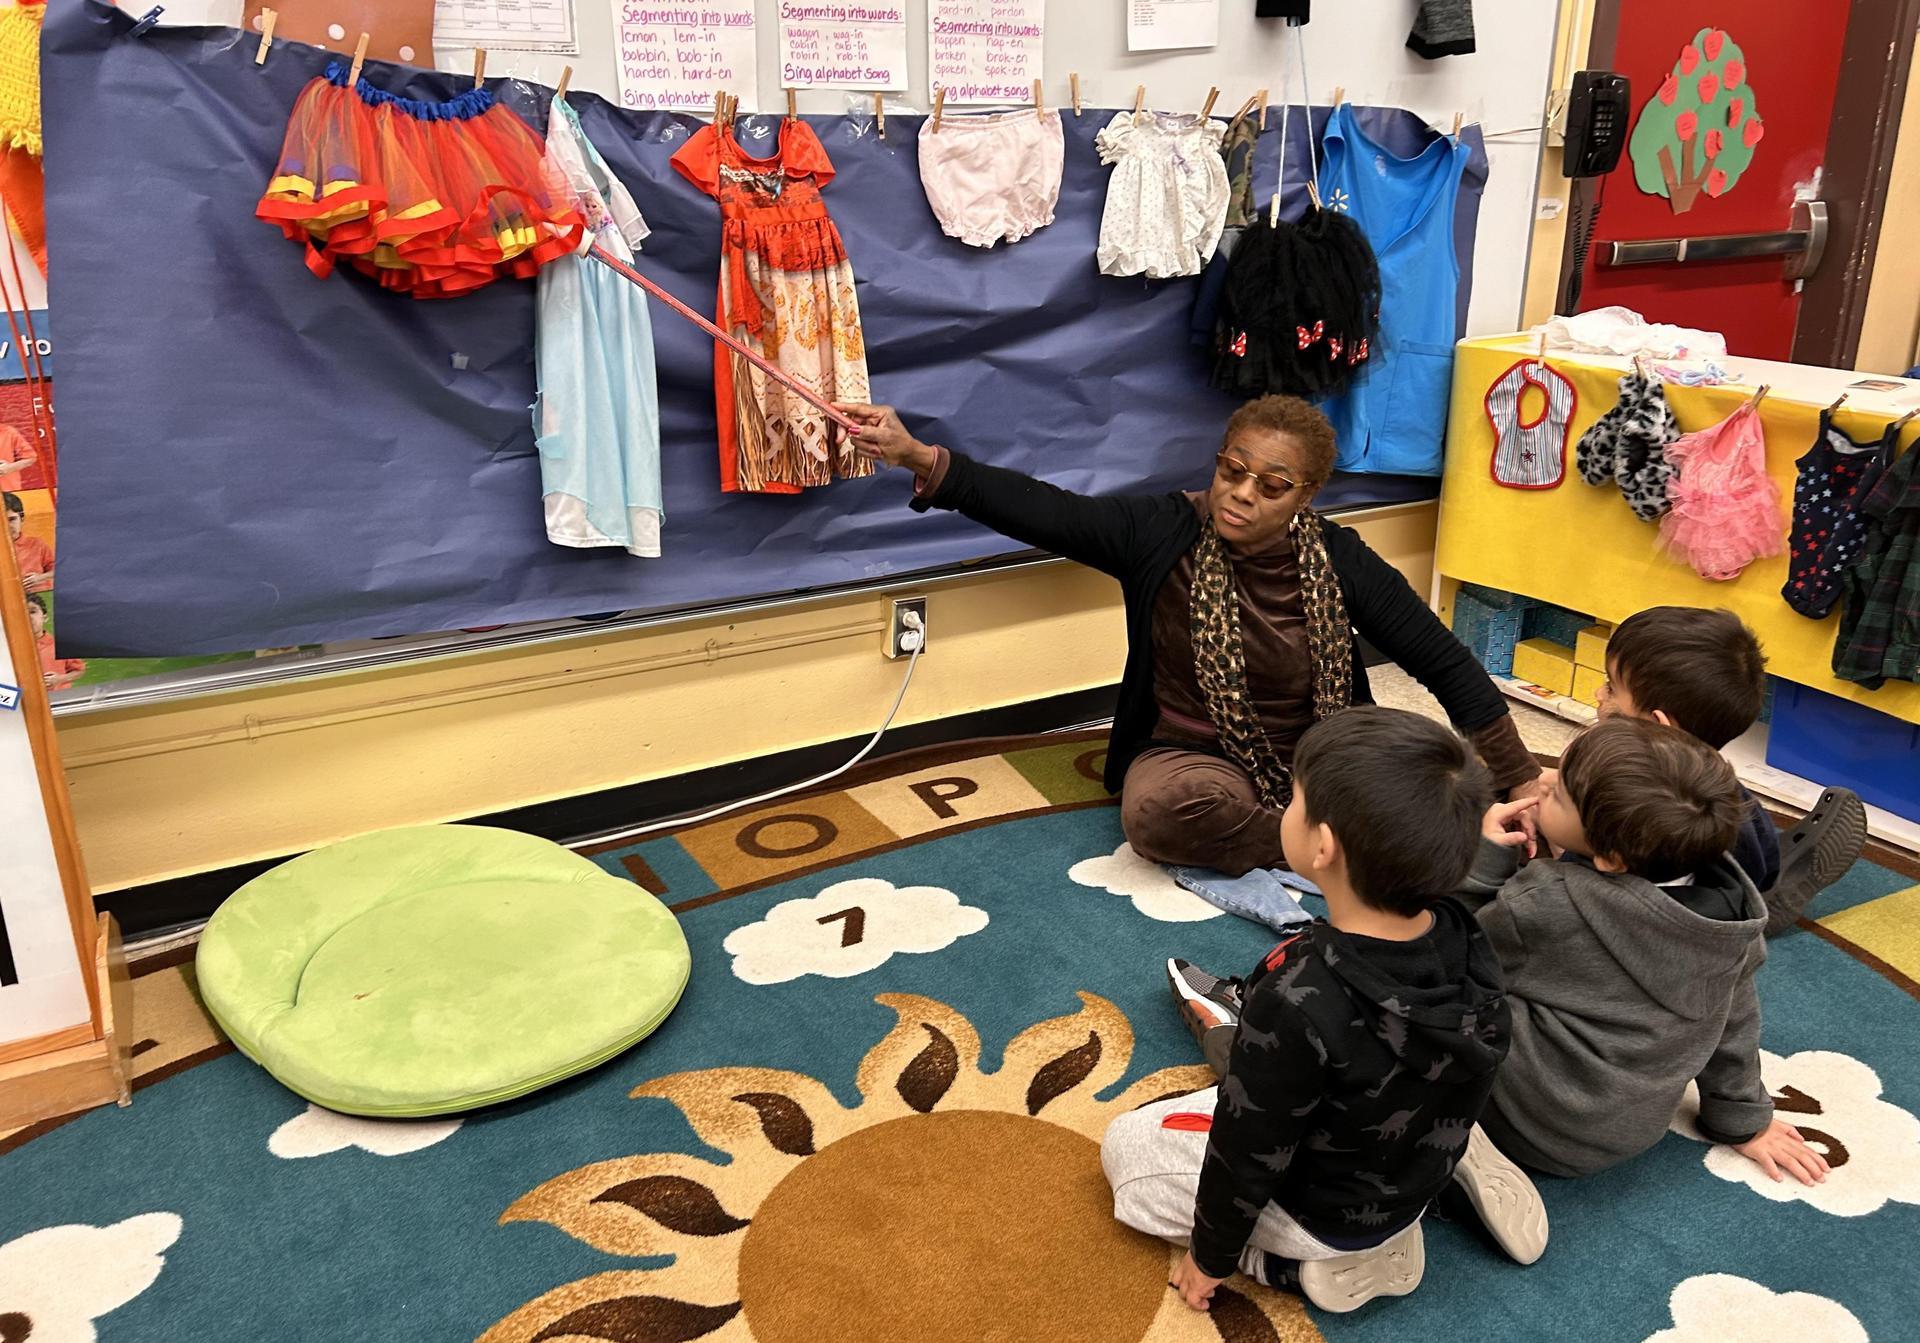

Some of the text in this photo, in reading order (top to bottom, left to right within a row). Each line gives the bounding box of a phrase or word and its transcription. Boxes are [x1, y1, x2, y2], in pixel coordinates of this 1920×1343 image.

[622, 4, 698, 27] Segmenting
[701, 9, 721, 24] into
[781, 2, 846, 22] Segmenting
[848, 4, 867, 18] into
[933, 17, 993, 34] Segmenting
[995, 22, 1012, 34] into
[783, 63, 812, 84] Sing
[815, 66, 862, 82] alphabet
[624, 88, 656, 109] Sing
[659, 90, 711, 106] alphabet
[933, 81, 1029, 101] Sng alphabet song
[735, 777, 979, 859] O P
[816, 906, 865, 948] 7
